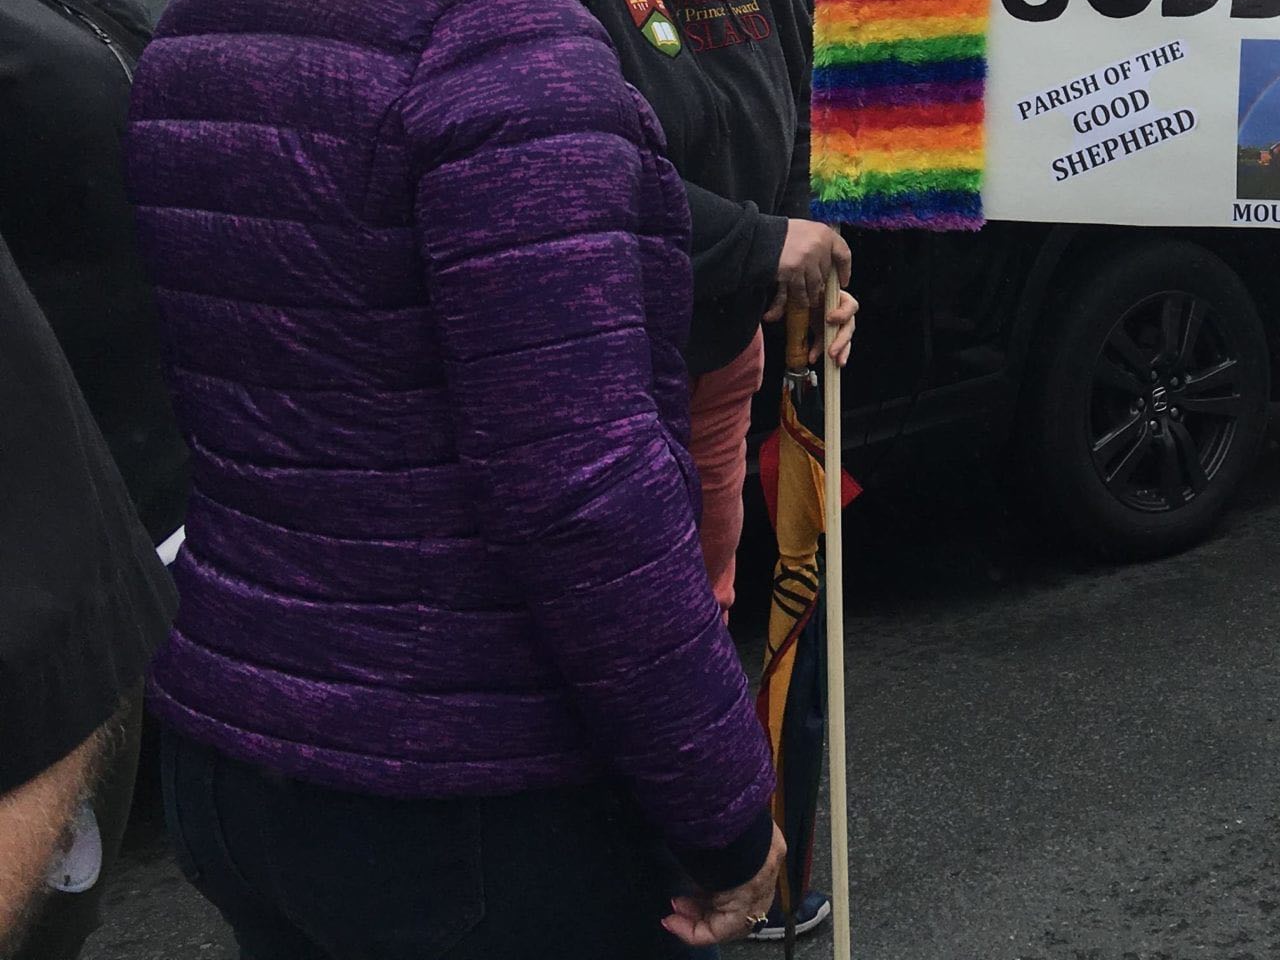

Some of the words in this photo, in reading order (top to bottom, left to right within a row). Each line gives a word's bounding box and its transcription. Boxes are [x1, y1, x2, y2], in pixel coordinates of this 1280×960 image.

[1017, 74, 1100, 121] PARISH
[1103, 60, 1132, 86] OF
[1135, 41, 1185, 72] THE
[1073, 88, 1150, 134] GOOD
[1052, 109, 1195, 182] SHEPHERD
